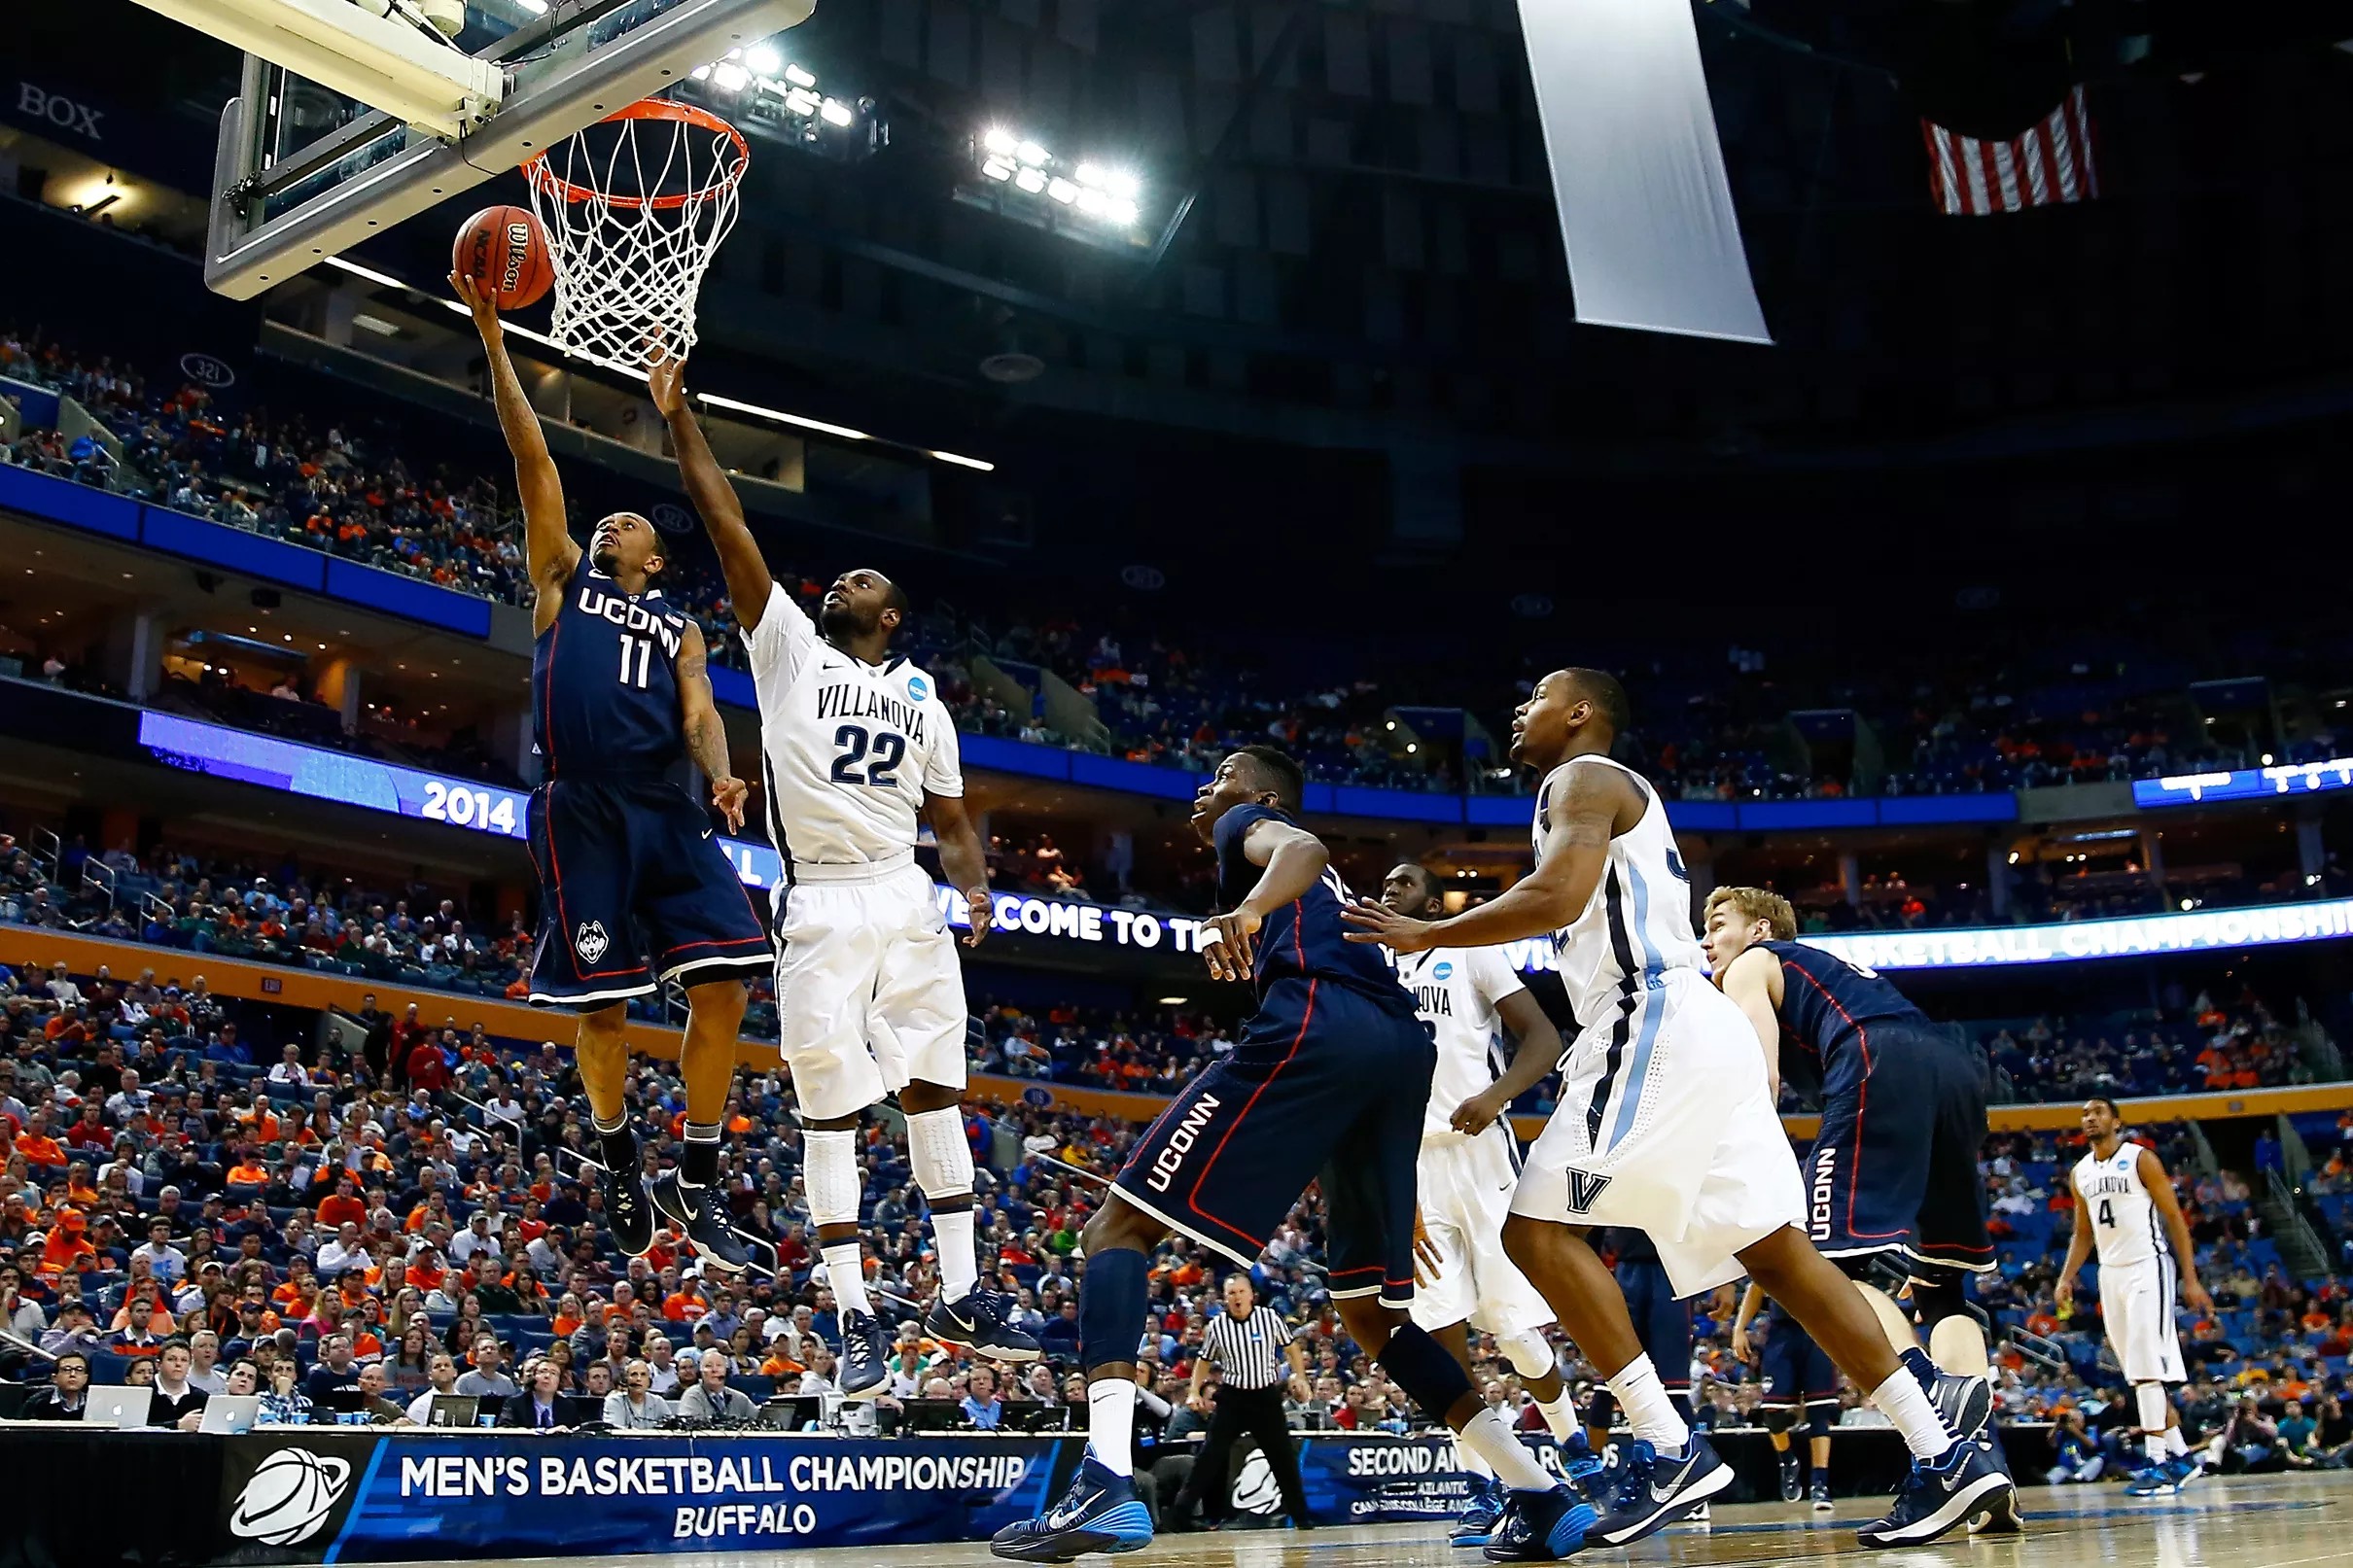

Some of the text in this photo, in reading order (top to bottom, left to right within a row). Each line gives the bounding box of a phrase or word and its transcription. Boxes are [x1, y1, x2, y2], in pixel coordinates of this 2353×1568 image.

[18, 82, 105, 140] BOX
[502, 223, 529, 292] Wilson
[578, 587, 681, 659] UCONN
[619, 634, 651, 688] 11
[817, 683, 925, 747] VILLANOVA
[830, 724, 906, 788] 22
[421, 781, 516, 834] 2014
[936, 886, 1103, 941] ECOME
[1110, 910, 1161, 948] TO
[1818, 930, 2052, 966] ASKETBALL
[1146, 1092, 1221, 1192] UCONN
[1565, 1166, 1613, 1214] V
[1810, 1148, 1837, 1241] UCONN
[2098, 1199, 2116, 1228] 4
[401, 1456, 1025, 1496] MEN'S BASKETBALL CHAMPIONSHIP
[1348, 1446, 1467, 1476] SECOND AN
[1417, 1481, 1469, 1495] ATLANTIC
[673, 1504, 817, 1538] BUFFALO
